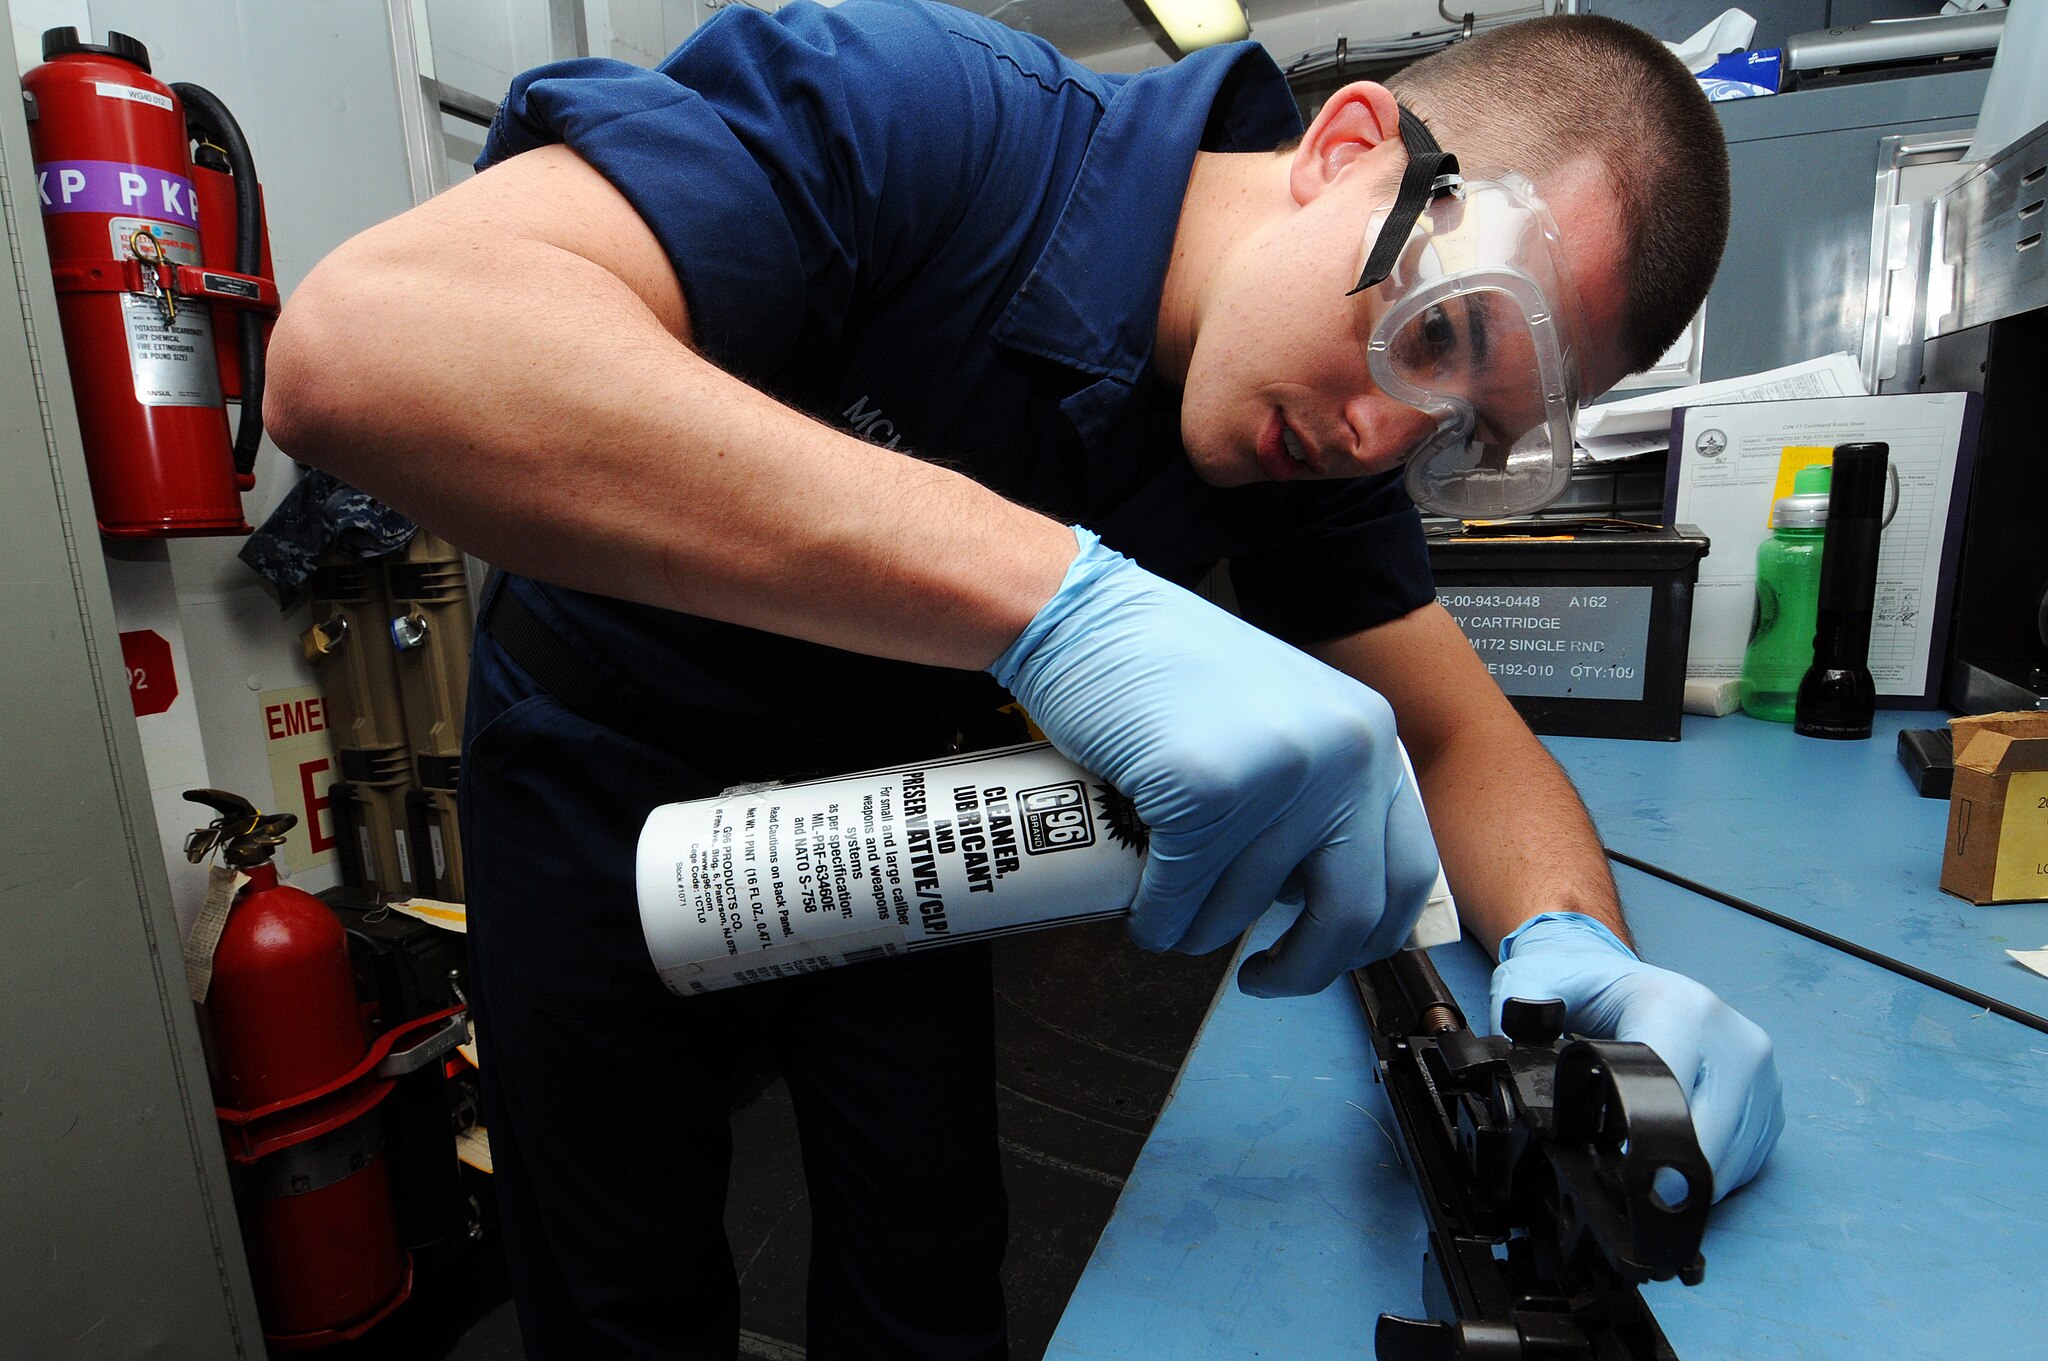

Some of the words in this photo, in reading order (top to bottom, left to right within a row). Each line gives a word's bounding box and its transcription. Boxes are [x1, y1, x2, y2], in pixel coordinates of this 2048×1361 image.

[153, 96, 166, 106] 012
[134, 324, 169, 333] POTASSIUM
[136, 333, 149, 341] DRY
[151, 334, 181, 343] CHEMICAL
[137, 343, 152, 351] FIRE
[154, 343, 194, 353] EXTINGUISHER
[151, 352, 172, 361] POUND
[1569, 596, 1608, 609] A162
[1471, 616, 1561, 630] CARTRIDGE
[1509, 639, 1566, 652] SINGLE
[1571, 641, 1605, 653] RND
[1483, 663, 1554, 677] E192-010
[1570, 666, 1635, 680] QTY:109
[880, 786, 893, 798] For
[746, 807, 757, 819] Net
[769, 806, 780, 823] Read
[829, 803, 839, 814] as
[861, 794, 875, 834] weapons
[880, 798, 894, 822] small
[794, 817, 806, 836] and
[826, 815, 839, 831] per
[982, 785, 1020, 880] CLEANER,
[1028, 814, 1043, 848] BRAND
[723, 826, 732, 844] G96
[768, 823, 779, 864] Cautions
[882, 824, 897, 848] and
[934, 819, 956, 855] AND
[953, 784, 994, 894] LUBRICANT
[689, 843, 699, 864] Cage
[711, 848, 720, 871] Bldg.
[744, 840, 755, 862] PINT
[794, 838, 810, 872] NATO
[844, 826, 863, 880] systems
[866, 837, 881, 862] and
[675, 861, 684, 882] Stock
[770, 865, 780, 879] on
[812, 812, 836, 913] MIL-PRF-63460E
[886, 850, 900, 885] large
[691, 866, 700, 893] Code:
[700, 850, 714, 912] www.g96.com
[712, 872, 721, 882] 6,
[722, 846, 738, 911] PRODUCTS
[744, 868, 758, 885] (16
[827, 834, 853, 919] specification:
[678, 884, 687, 907] #1071
[749, 886, 760, 900] FL
[772, 881, 787, 908] Back
[799, 874, 817, 914] S-758
[870, 864, 890, 921] weapons
[714, 884, 727, 926] Paterson,
[892, 887, 910, 926] caliber
[723, 927, 733, 939] NJ
[730, 912, 742, 933] CO.
[756, 922, 770, 941] 0.47
[778, 909, 794, 938] Panel.
